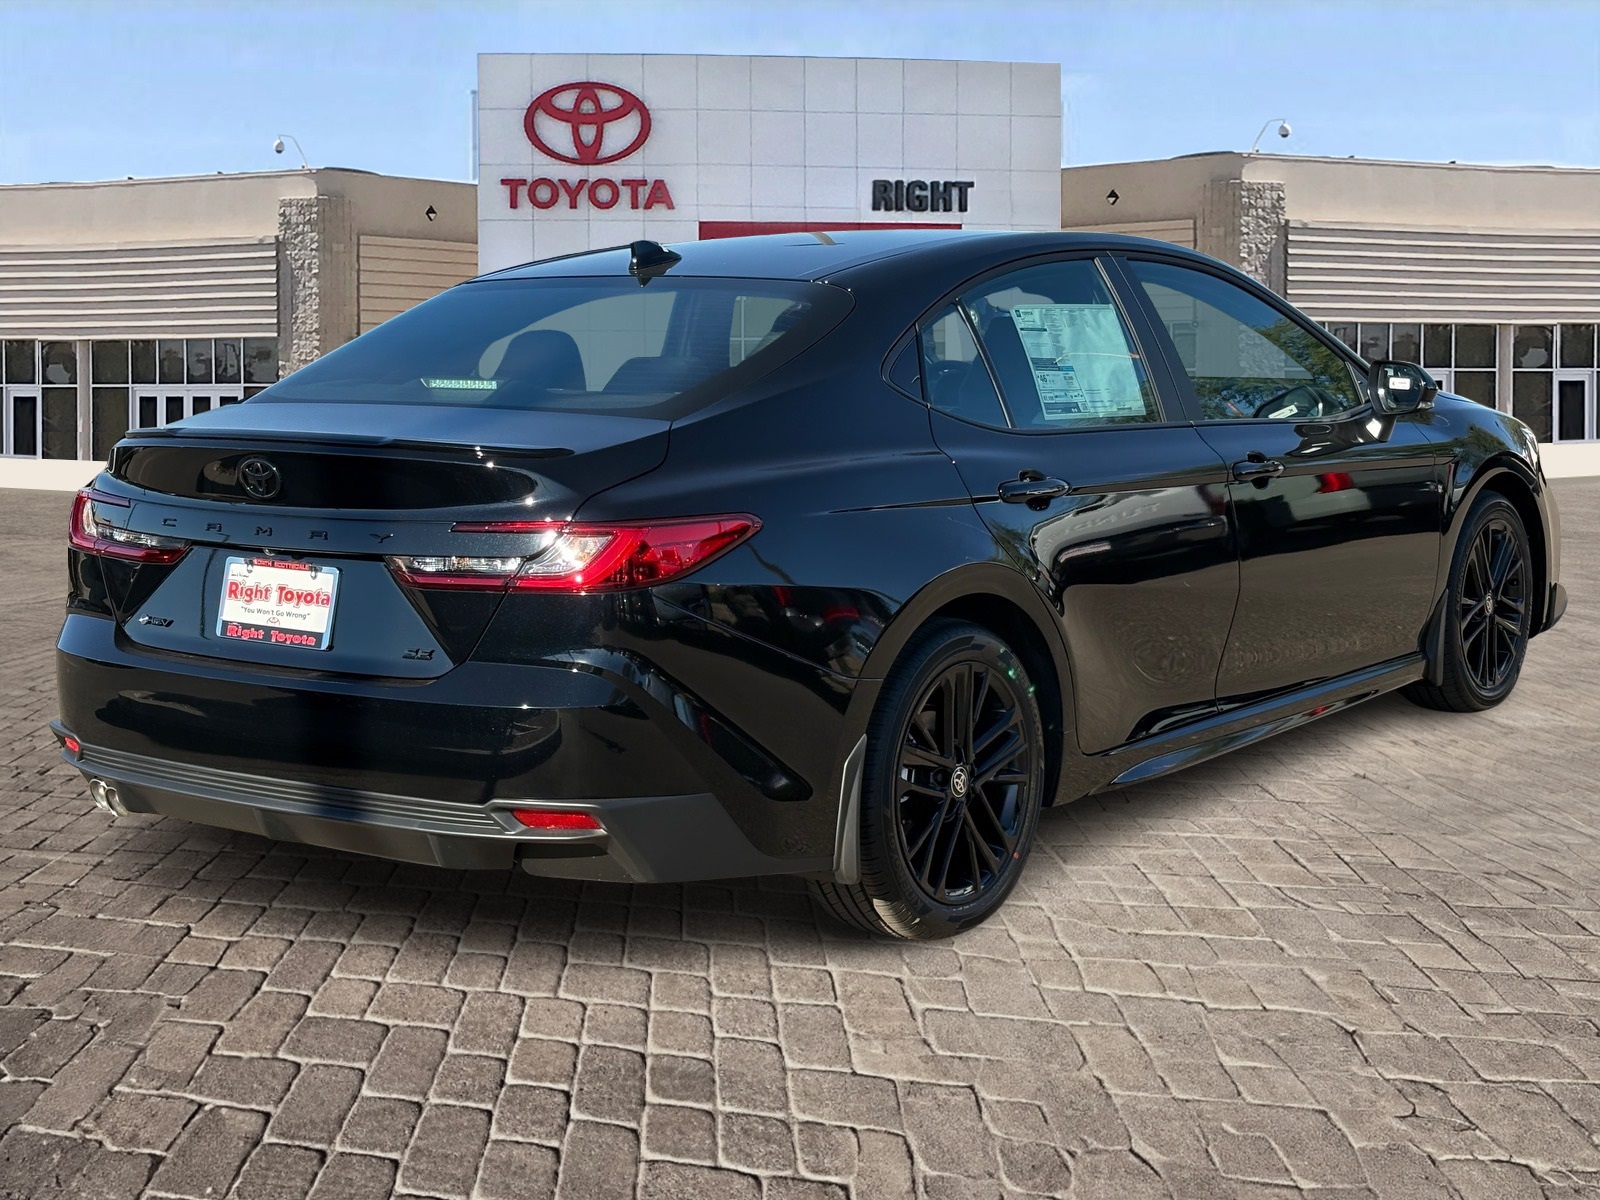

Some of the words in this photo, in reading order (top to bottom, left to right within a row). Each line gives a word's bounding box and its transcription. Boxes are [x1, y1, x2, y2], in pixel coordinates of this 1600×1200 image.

[500, 178, 675, 210] TOYOTA
[871, 179, 975, 212] RIGHT
[161, 518, 394, 543] CAMRY
[227, 580, 272, 603] Right
[276, 584, 332, 607] Toyota
[256, 607, 275, 616] Won't
[226, 624, 265, 640] Right
[270, 629, 316, 646] Toyota
